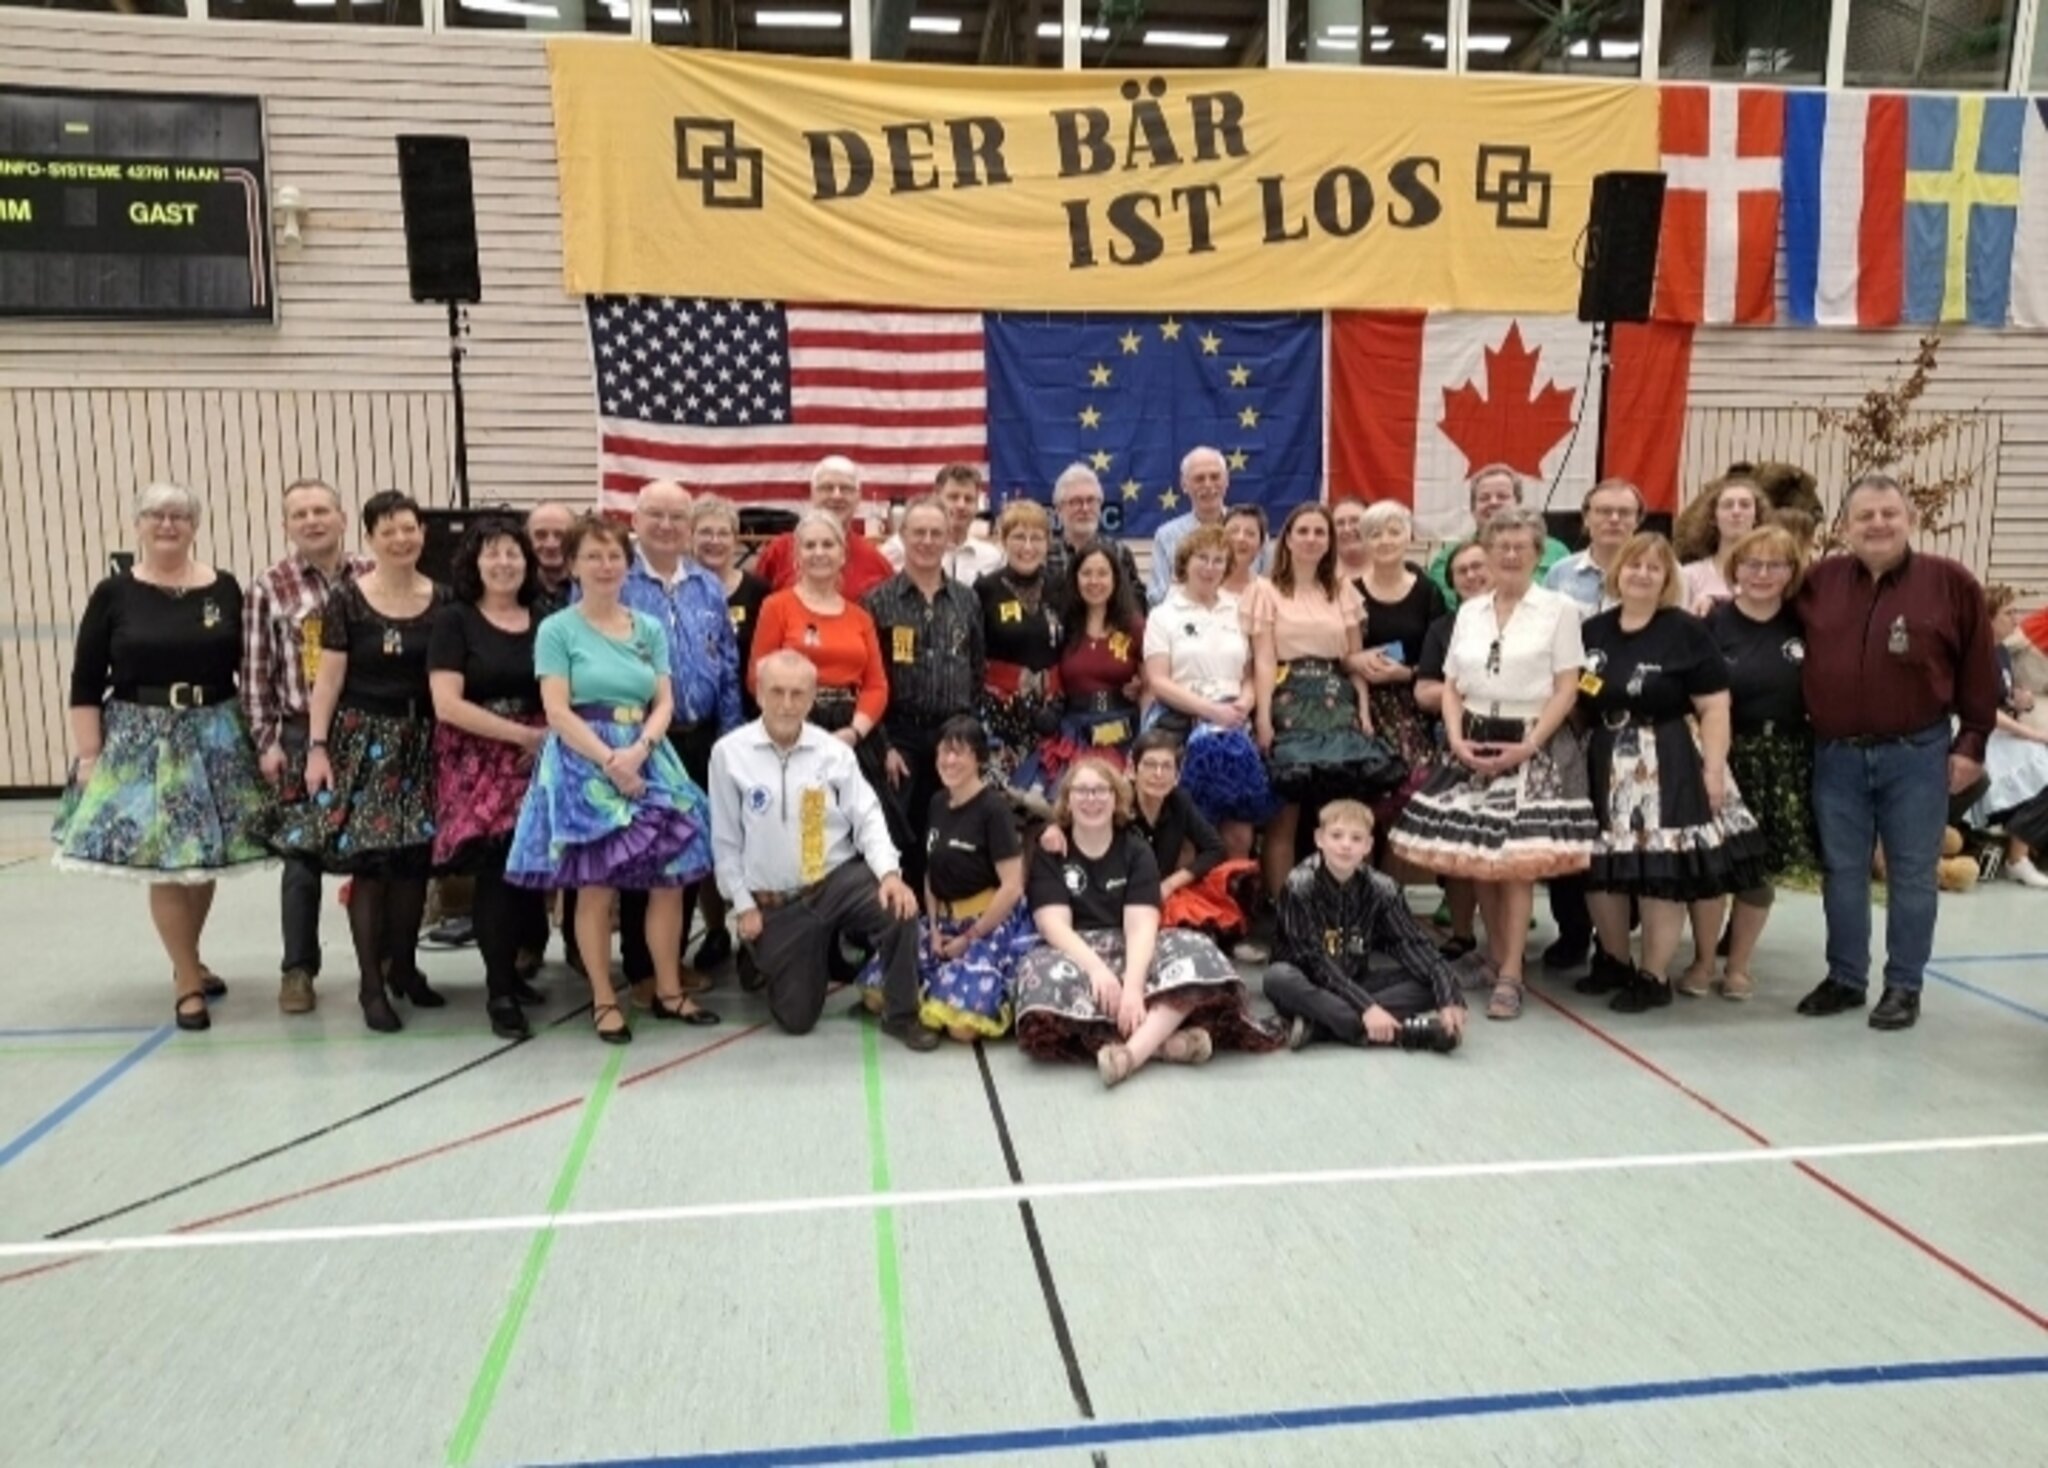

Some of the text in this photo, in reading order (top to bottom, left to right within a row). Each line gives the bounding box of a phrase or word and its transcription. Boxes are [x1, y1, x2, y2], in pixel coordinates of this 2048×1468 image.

[802, 76, 1249, 201] DER BÄR
[175, 166, 220, 182] HAAN
[129, 201, 199, 226] GAST
[1061, 156, 1443, 270] IST LOS
